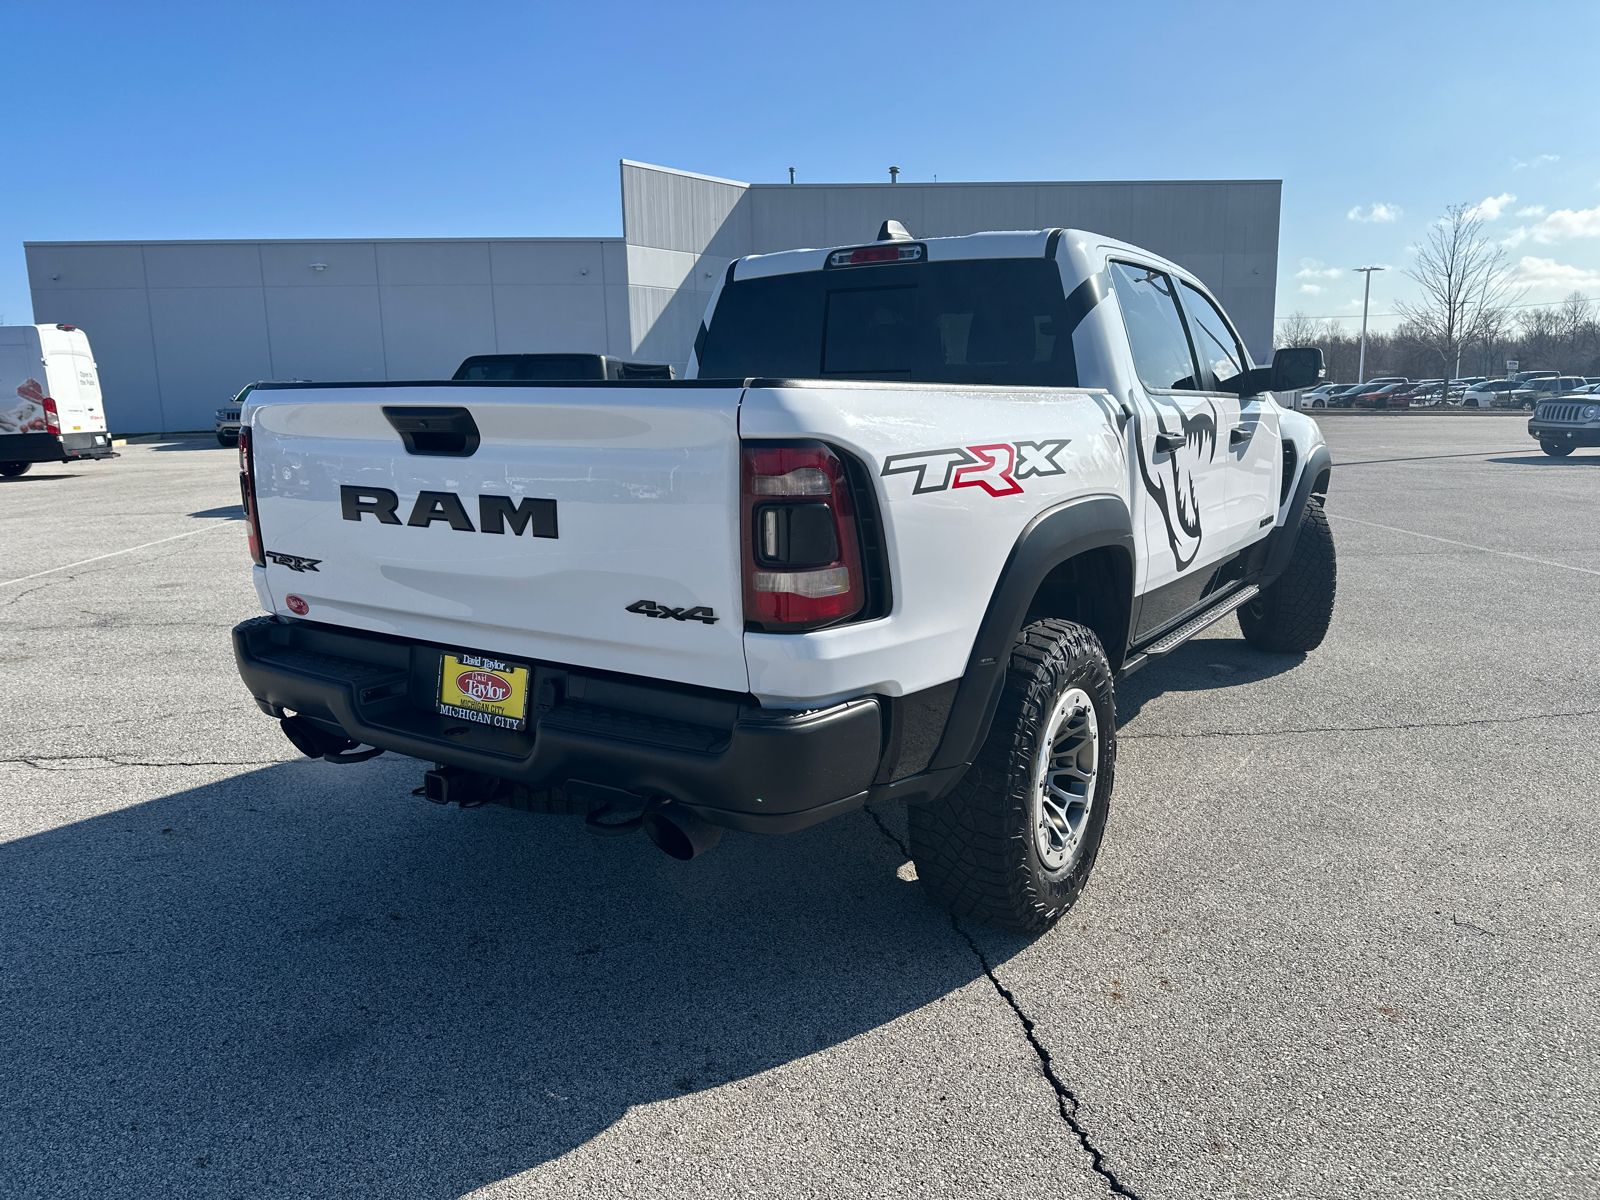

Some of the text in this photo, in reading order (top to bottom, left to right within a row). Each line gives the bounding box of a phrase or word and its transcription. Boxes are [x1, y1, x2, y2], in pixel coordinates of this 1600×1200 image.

[880, 438, 1072, 498] TRX
[340, 484, 559, 539] RAM
[266, 550, 323, 573] TRX
[625, 599, 720, 625] 4x4
[462, 654, 506, 672] David Taylor
[471, 672, 487, 682] David
[465, 679, 506, 701] Taylor
[440, 704, 520, 730] MICHIGAN CITY
[460, 699, 505, 715] MICHIGAN CITY
